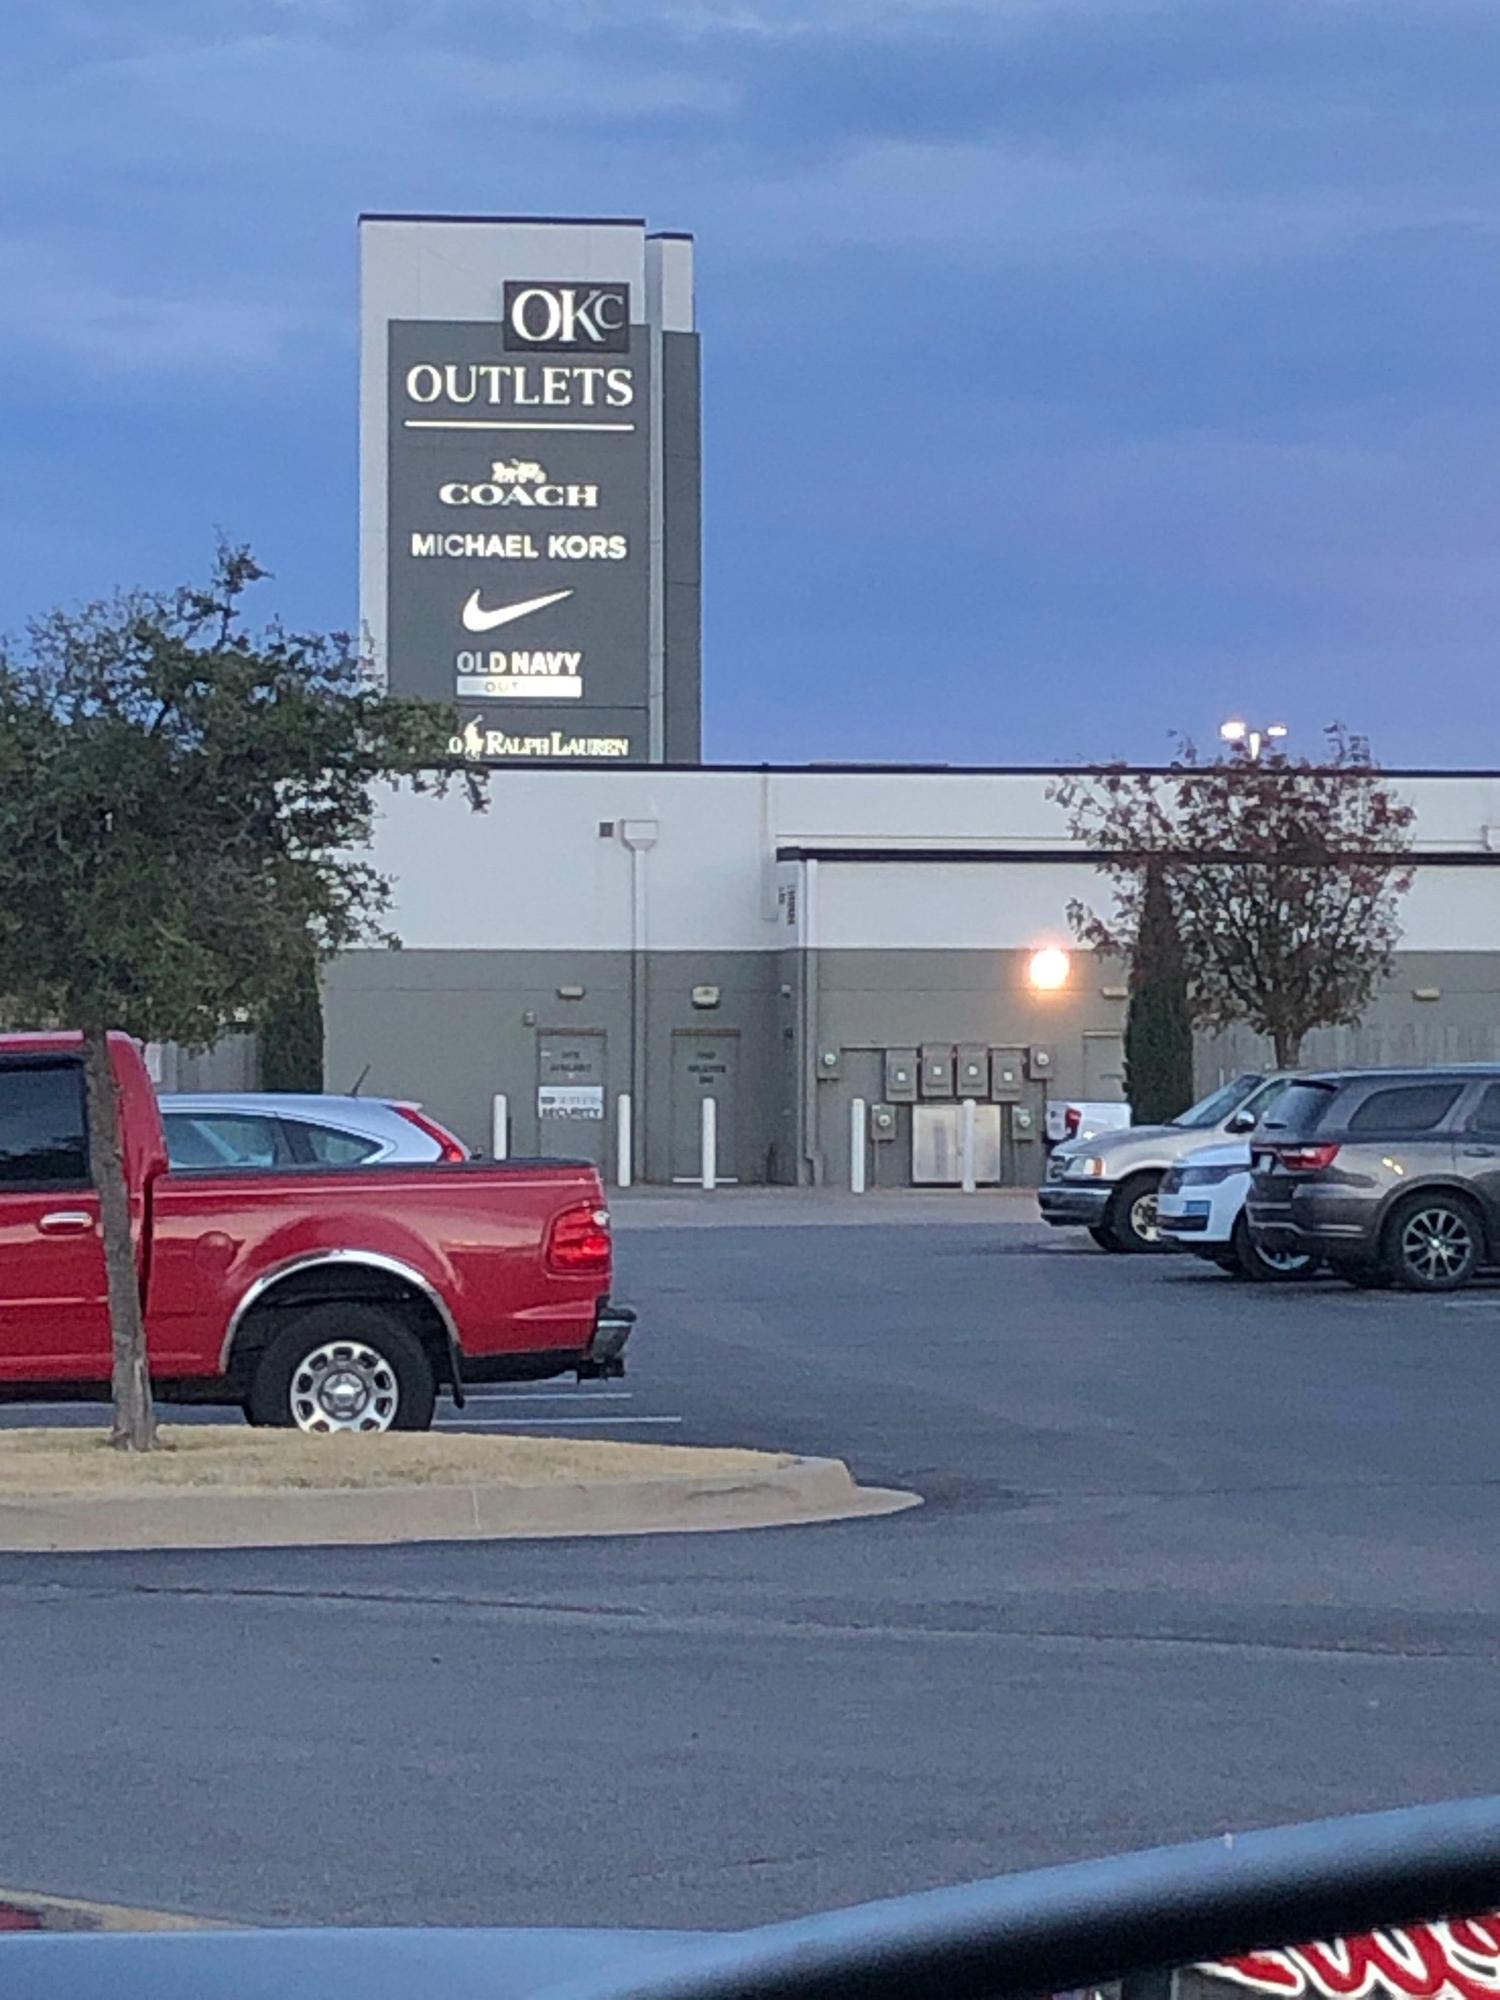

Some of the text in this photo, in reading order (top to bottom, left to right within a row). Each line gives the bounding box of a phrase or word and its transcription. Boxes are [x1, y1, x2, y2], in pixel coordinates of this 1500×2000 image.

[511, 288, 624, 342] OKC
[406, 364, 634, 407] OUTLETS
[439, 482, 599, 508] COACH
[411, 532, 628, 560] MICHAEL KORS
[457, 651, 582, 675] OLD NAVY
[485, 730, 549, 756] RALPH
[550, 731, 630, 757] LAUREN
